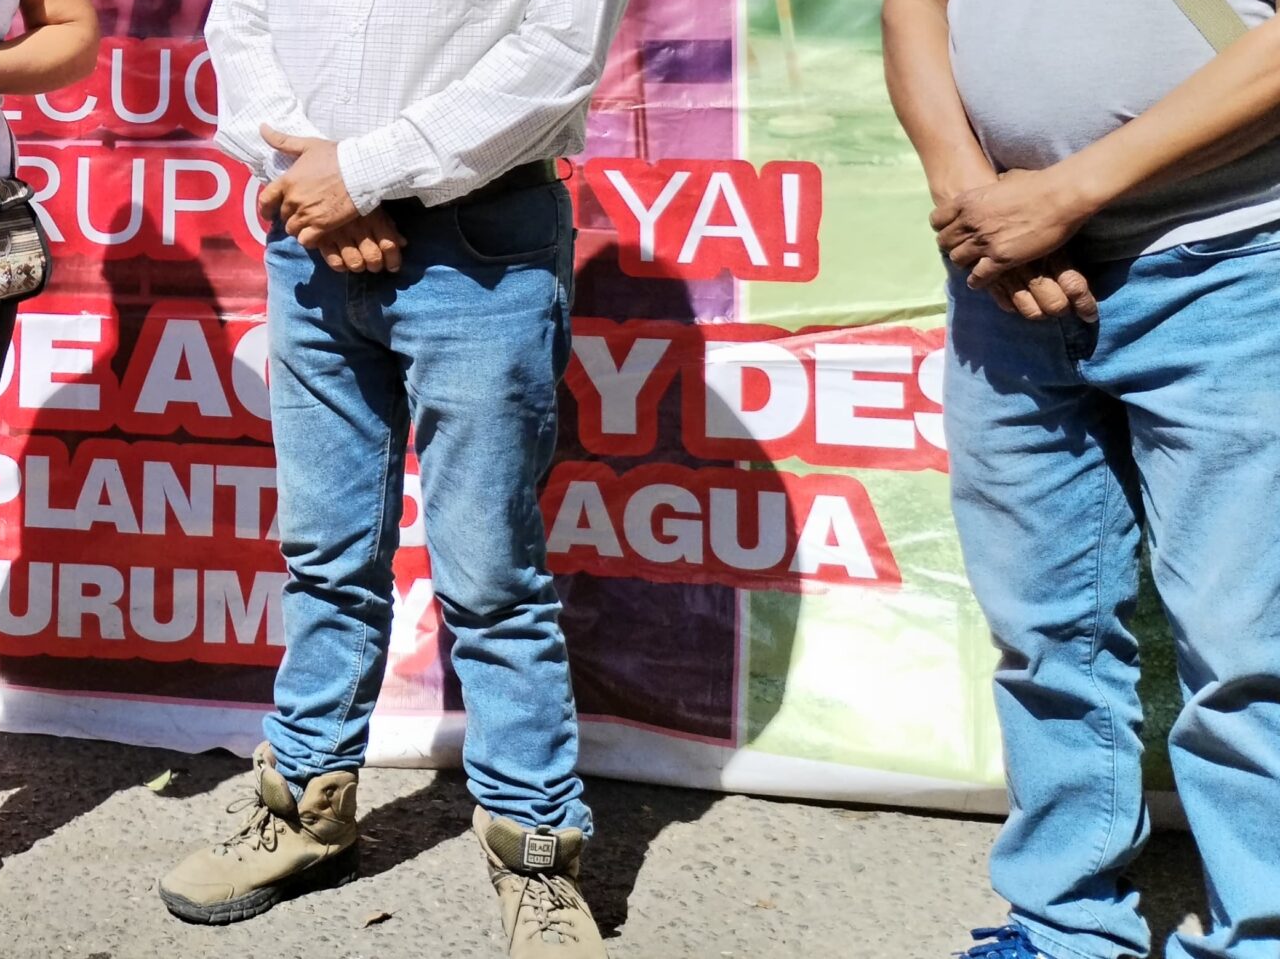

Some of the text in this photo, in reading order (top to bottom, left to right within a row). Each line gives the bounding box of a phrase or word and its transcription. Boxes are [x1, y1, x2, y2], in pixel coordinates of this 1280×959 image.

[603, 169, 801, 268] YA!
[572, 335, 673, 435] Y
[546, 480, 878, 579] AGUA
[528, 854, 551, 864] GOLD
